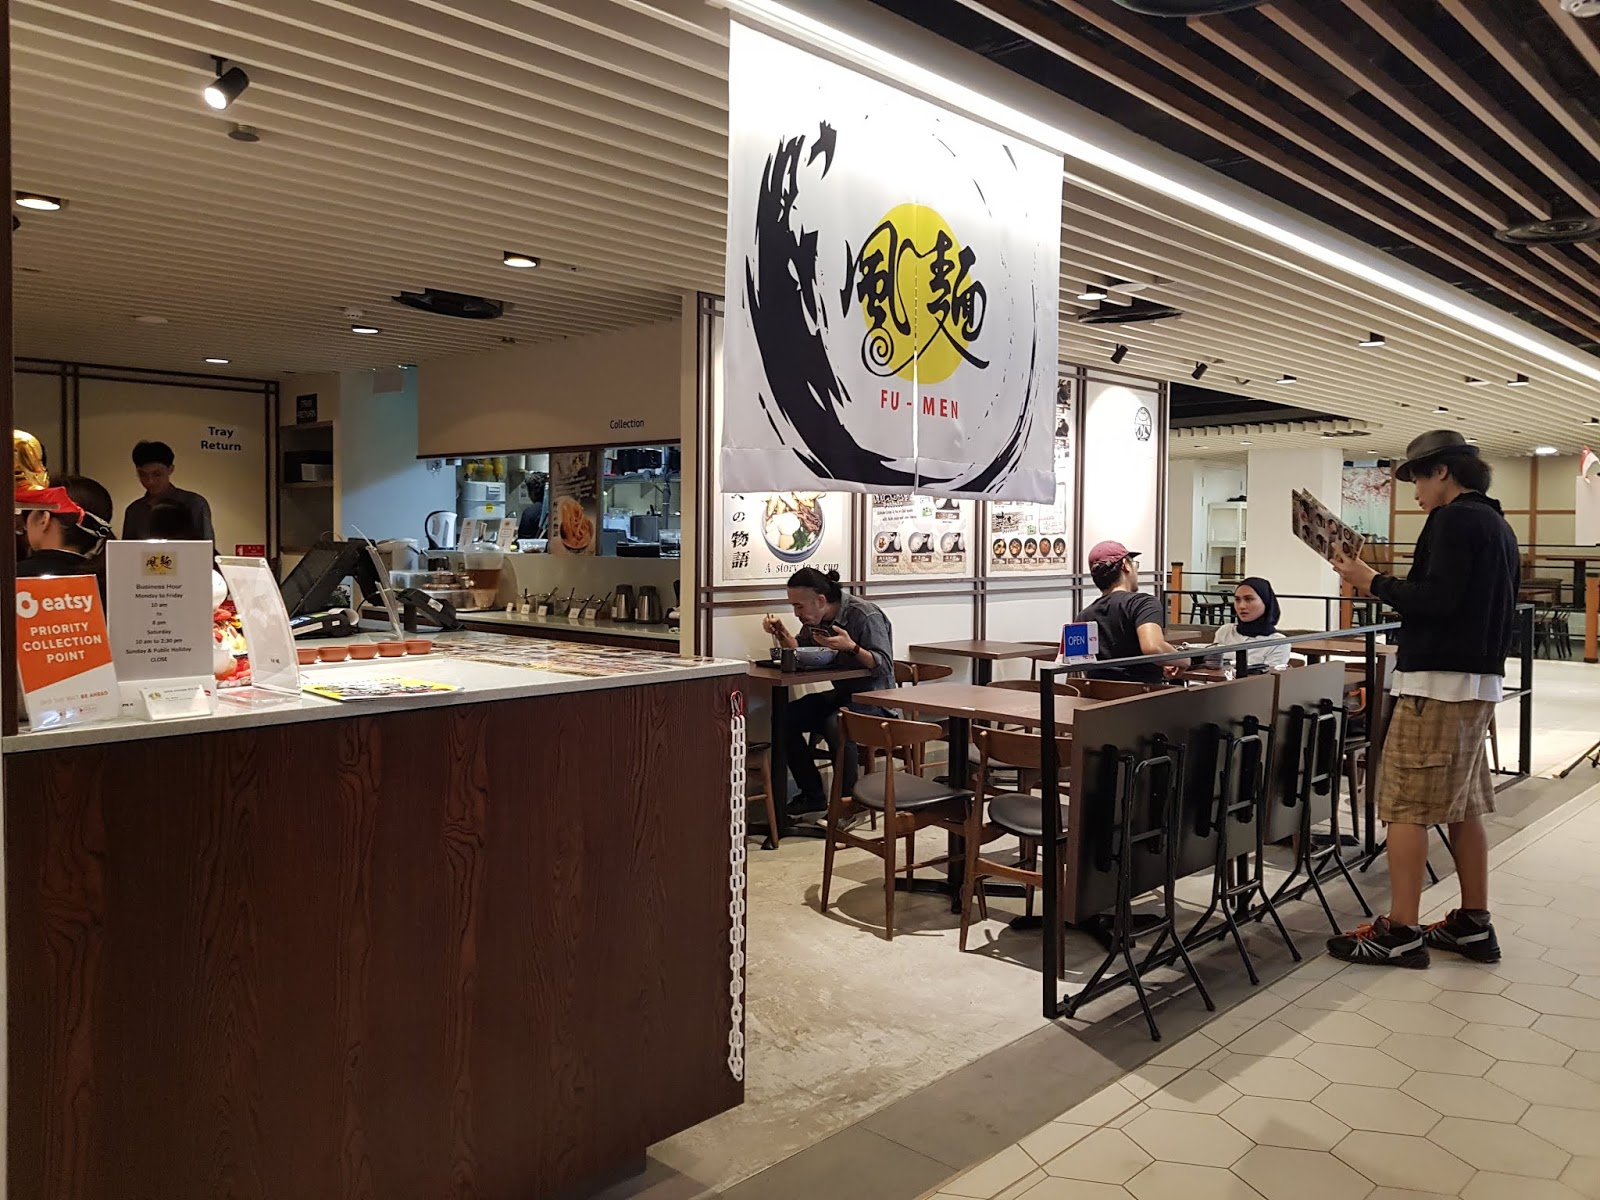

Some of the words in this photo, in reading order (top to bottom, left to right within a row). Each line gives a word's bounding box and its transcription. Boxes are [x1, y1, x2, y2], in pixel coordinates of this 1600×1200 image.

[923, 396, 958, 419] MEN
[609, 419, 645, 430] Collection
[208, 426, 234, 438] Tray
[200, 440, 242, 451] Return
[765, 563, 771, 573] A
[775, 563, 799, 574] story
[42, 593, 93, 613] eatsy
[30, 621, 89, 637] PRIORITY
[22, 634, 102, 651] COLLECTION
[1068, 635, 1086, 646] OPEN
[46, 650, 86, 664] POINT
[89, 690, 109, 698] AHEAD
